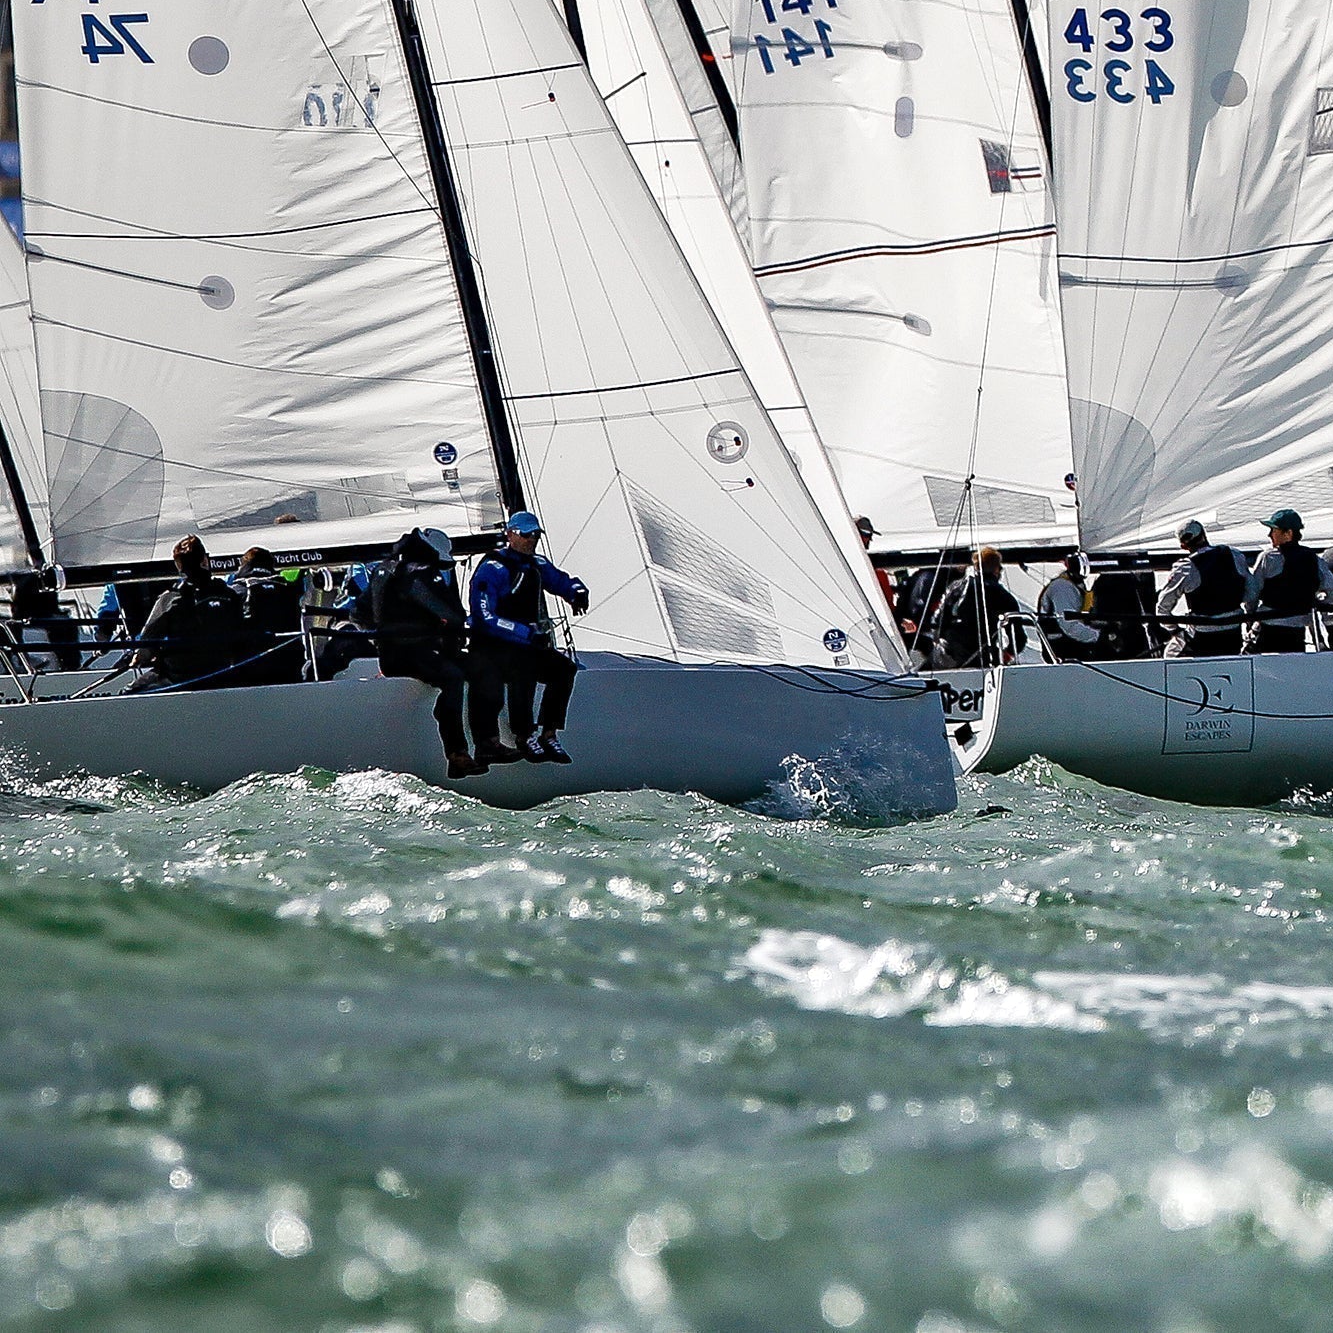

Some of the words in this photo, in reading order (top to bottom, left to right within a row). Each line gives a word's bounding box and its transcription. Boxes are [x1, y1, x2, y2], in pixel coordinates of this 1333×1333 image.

[1063, 8, 1174, 52] 433
[210, 558, 236, 569] Royal
[274, 553, 300, 564] Yacht
[301, 551, 323, 562] Club
[1185, 720, 1231, 731] DARWIN
[1185, 730, 1231, 741] ESCAPES
